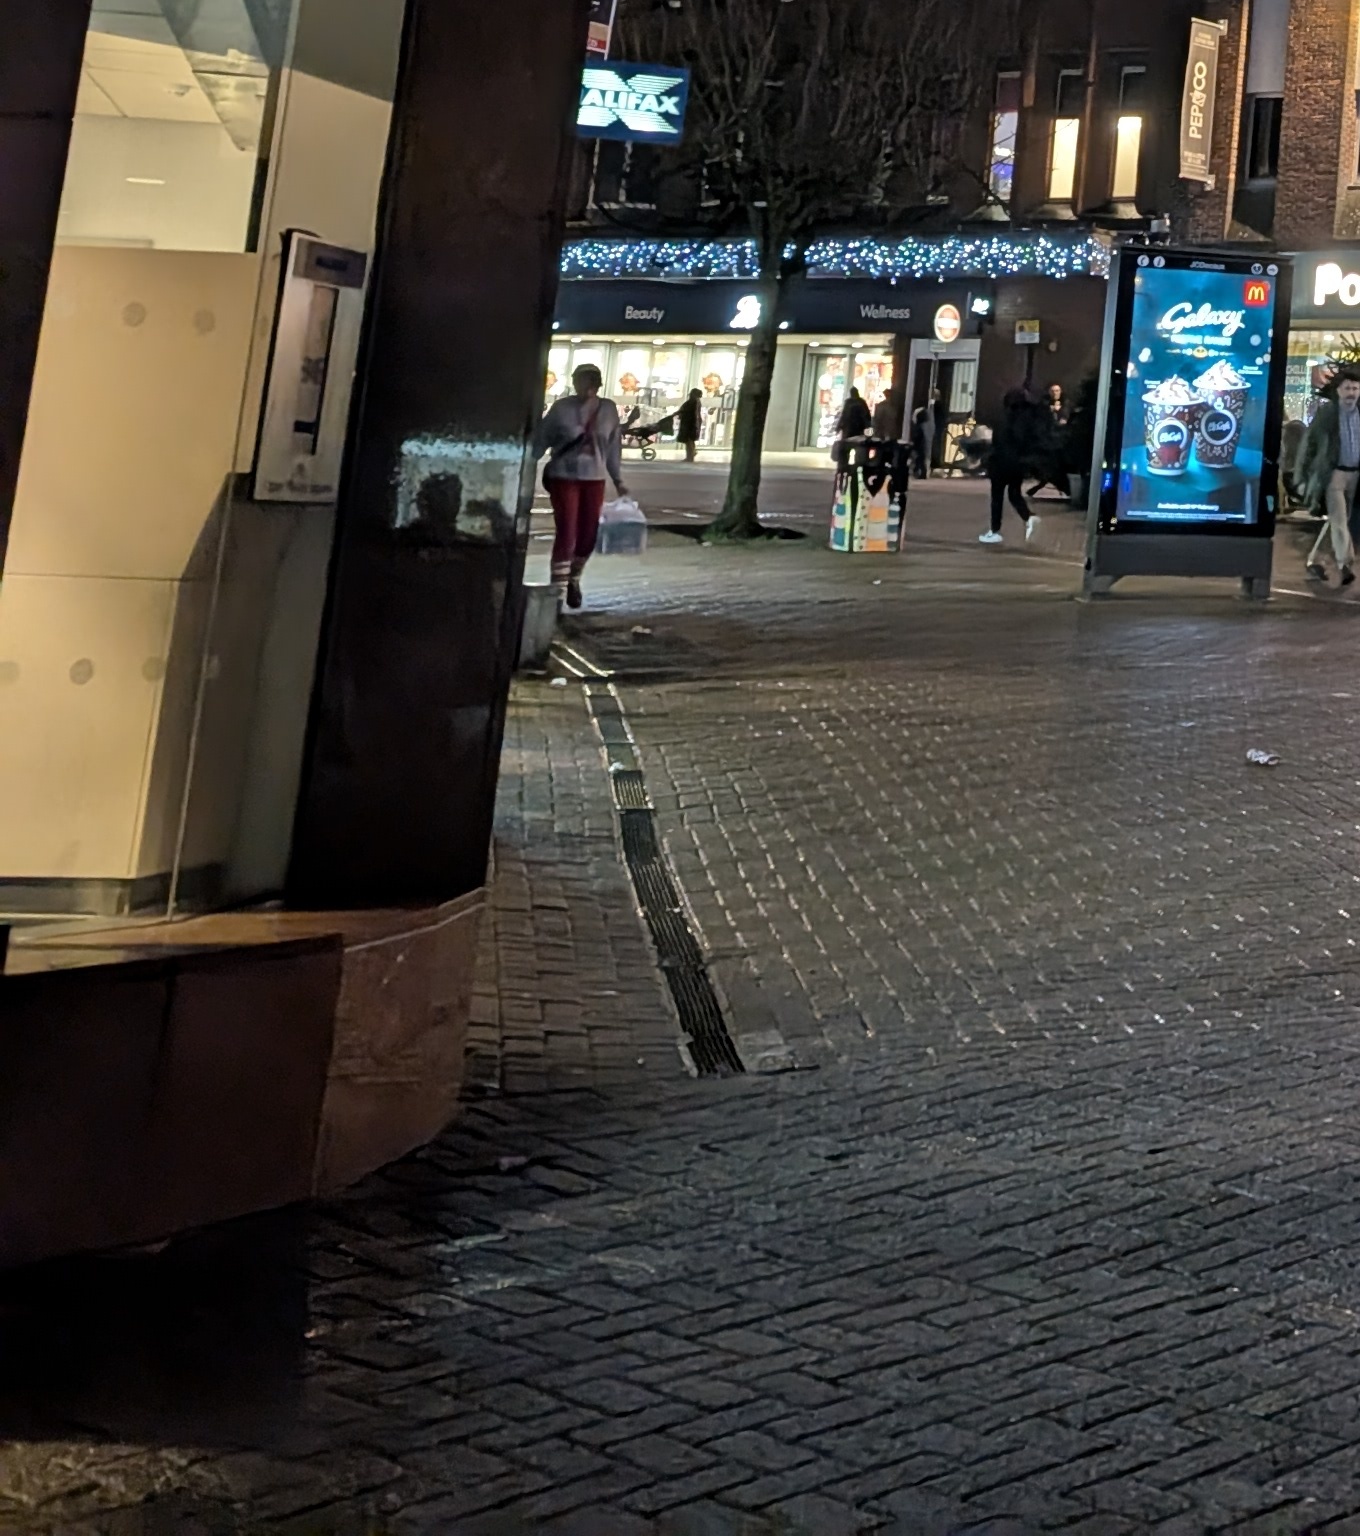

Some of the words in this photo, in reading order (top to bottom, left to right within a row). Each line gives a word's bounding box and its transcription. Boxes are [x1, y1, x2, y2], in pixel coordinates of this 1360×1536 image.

[581, 89, 680, 116] ALIFAX
[625, 305, 665, 323] Beauty
[860, 304, 911, 319] Wellness
[1156, 302, 1246, 337] Galaxy
